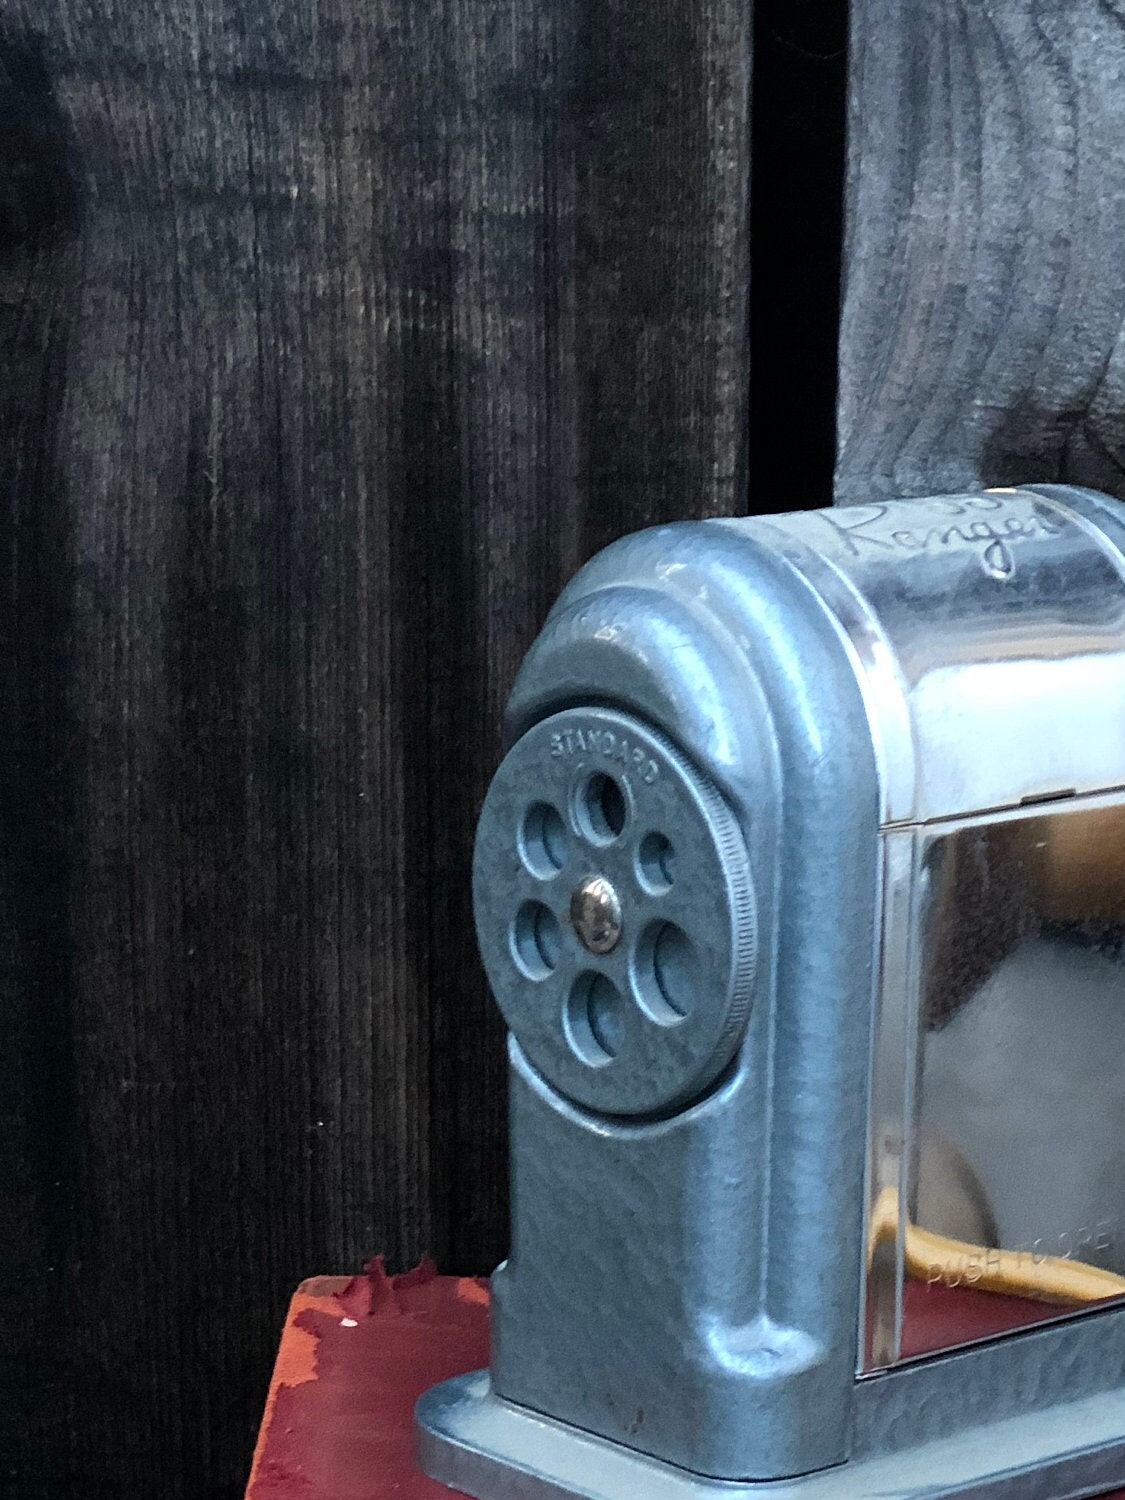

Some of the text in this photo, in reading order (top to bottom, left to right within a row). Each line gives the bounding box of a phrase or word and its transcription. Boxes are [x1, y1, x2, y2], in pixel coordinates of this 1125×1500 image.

[550, 728, 660, 784] STANDARD
[926, 1217, 1122, 1293] PUSH TO OPE
